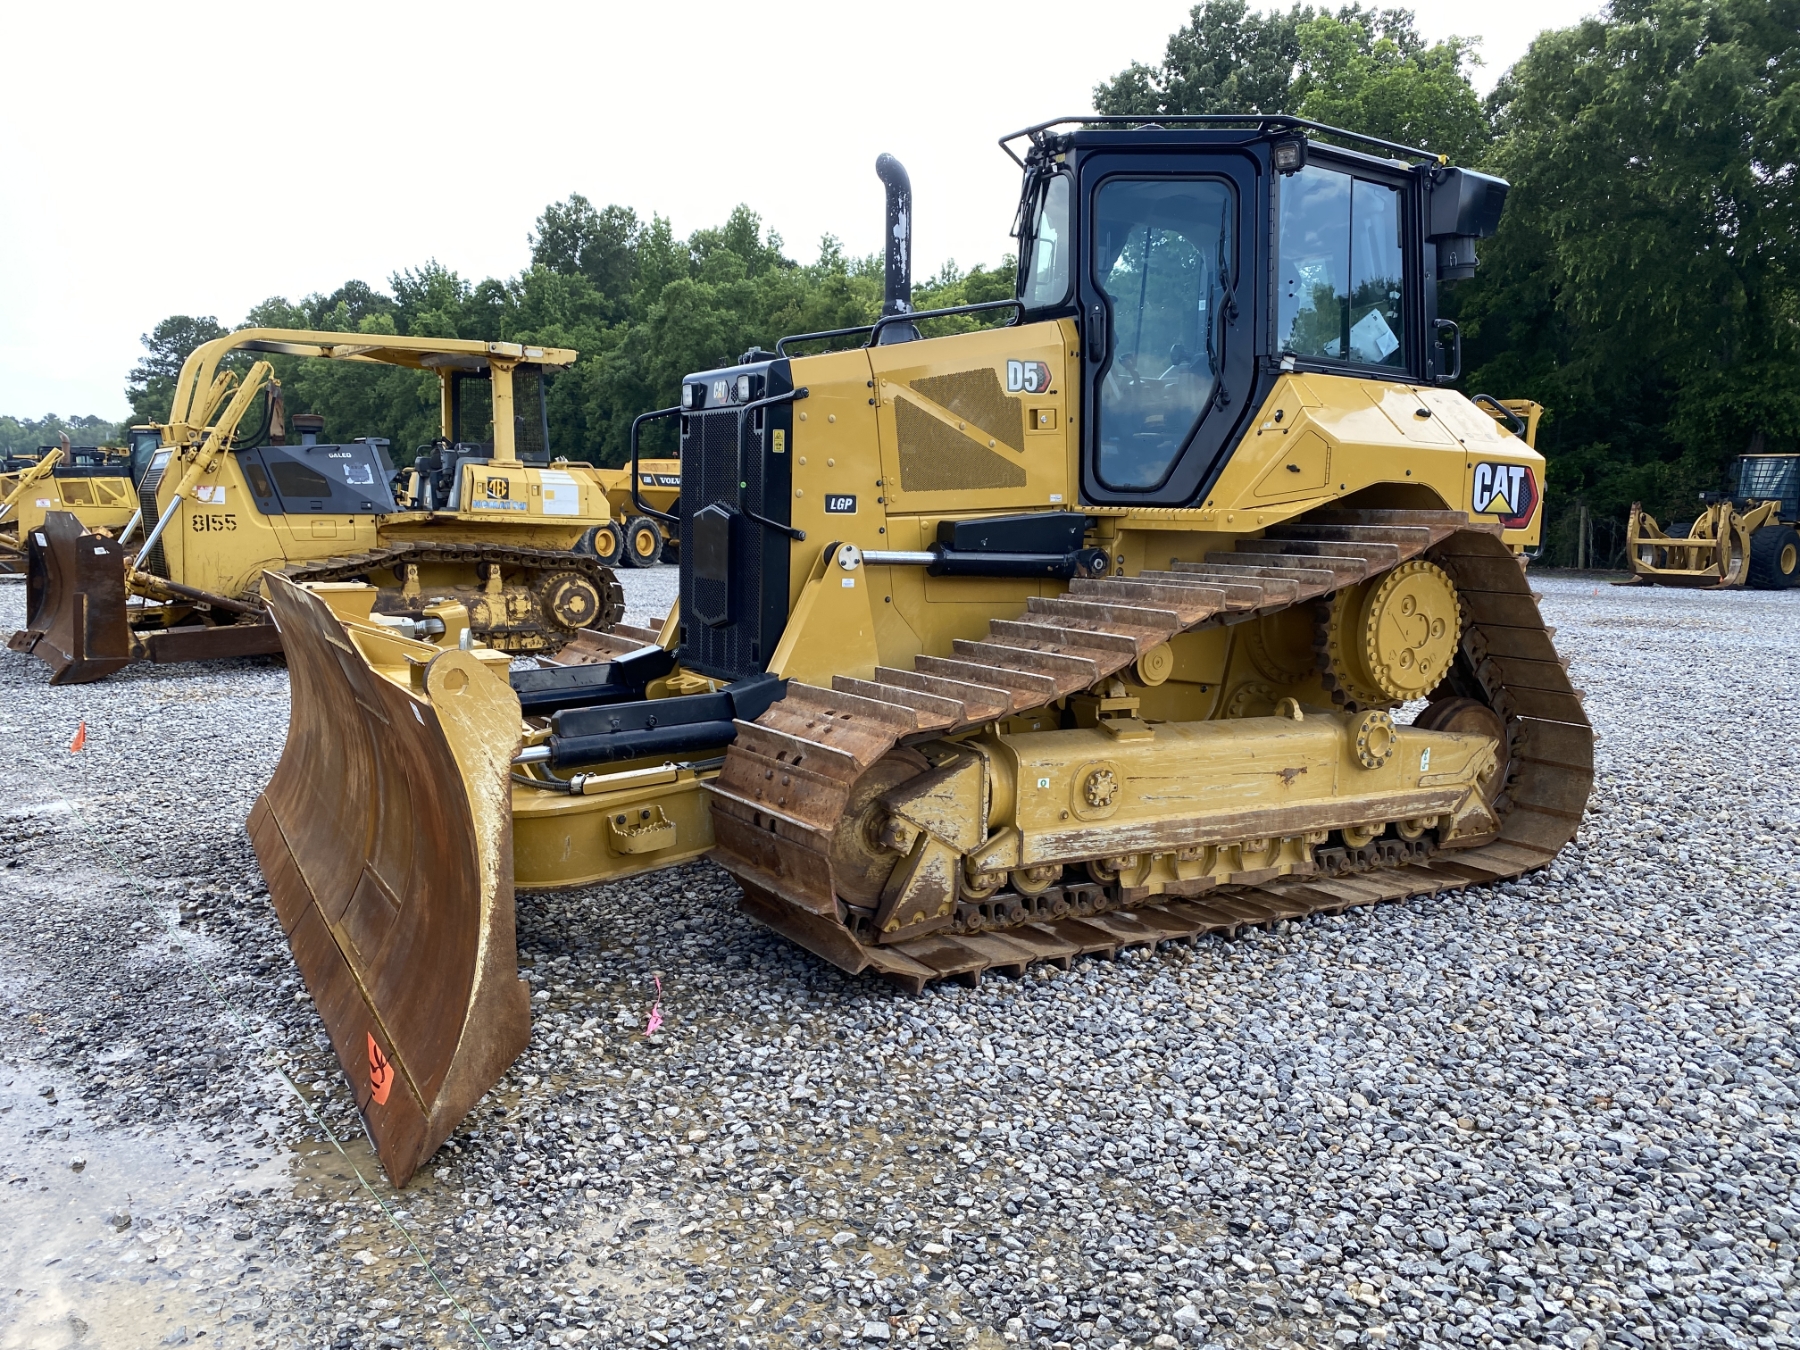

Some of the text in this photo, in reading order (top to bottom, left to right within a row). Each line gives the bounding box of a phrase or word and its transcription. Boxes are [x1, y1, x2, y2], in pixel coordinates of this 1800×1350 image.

[1007, 361, 1038, 392] D5
[713, 381, 727, 399] CAT
[660, 477, 681, 485] VOLV
[1473, 463, 1525, 514] CAT
[830, 497, 853, 510] LGP
[192, 514, 237, 532] 8155
